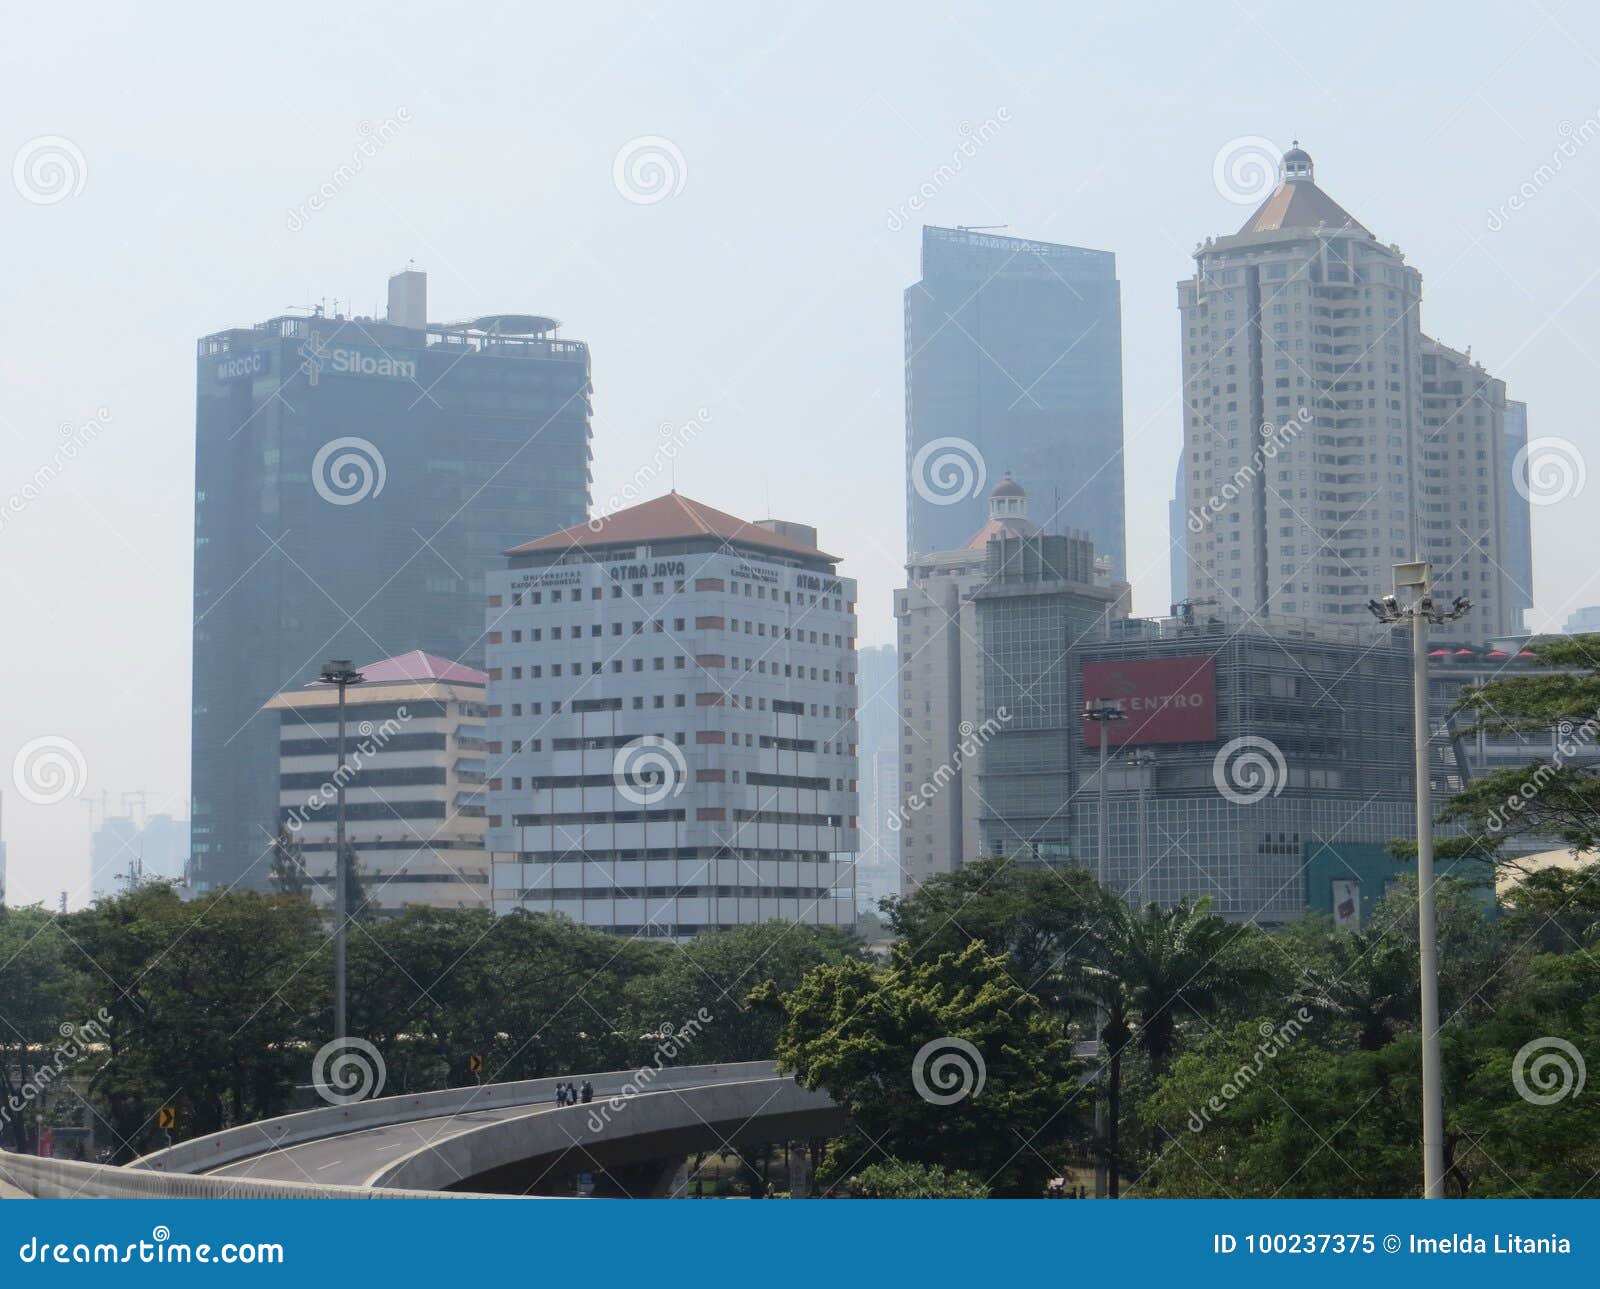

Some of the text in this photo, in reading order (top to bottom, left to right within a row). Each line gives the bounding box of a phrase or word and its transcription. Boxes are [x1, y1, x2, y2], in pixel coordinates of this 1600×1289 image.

[331, 350, 416, 378] Siloam
[610, 561, 685, 580] ATMA JAYA
